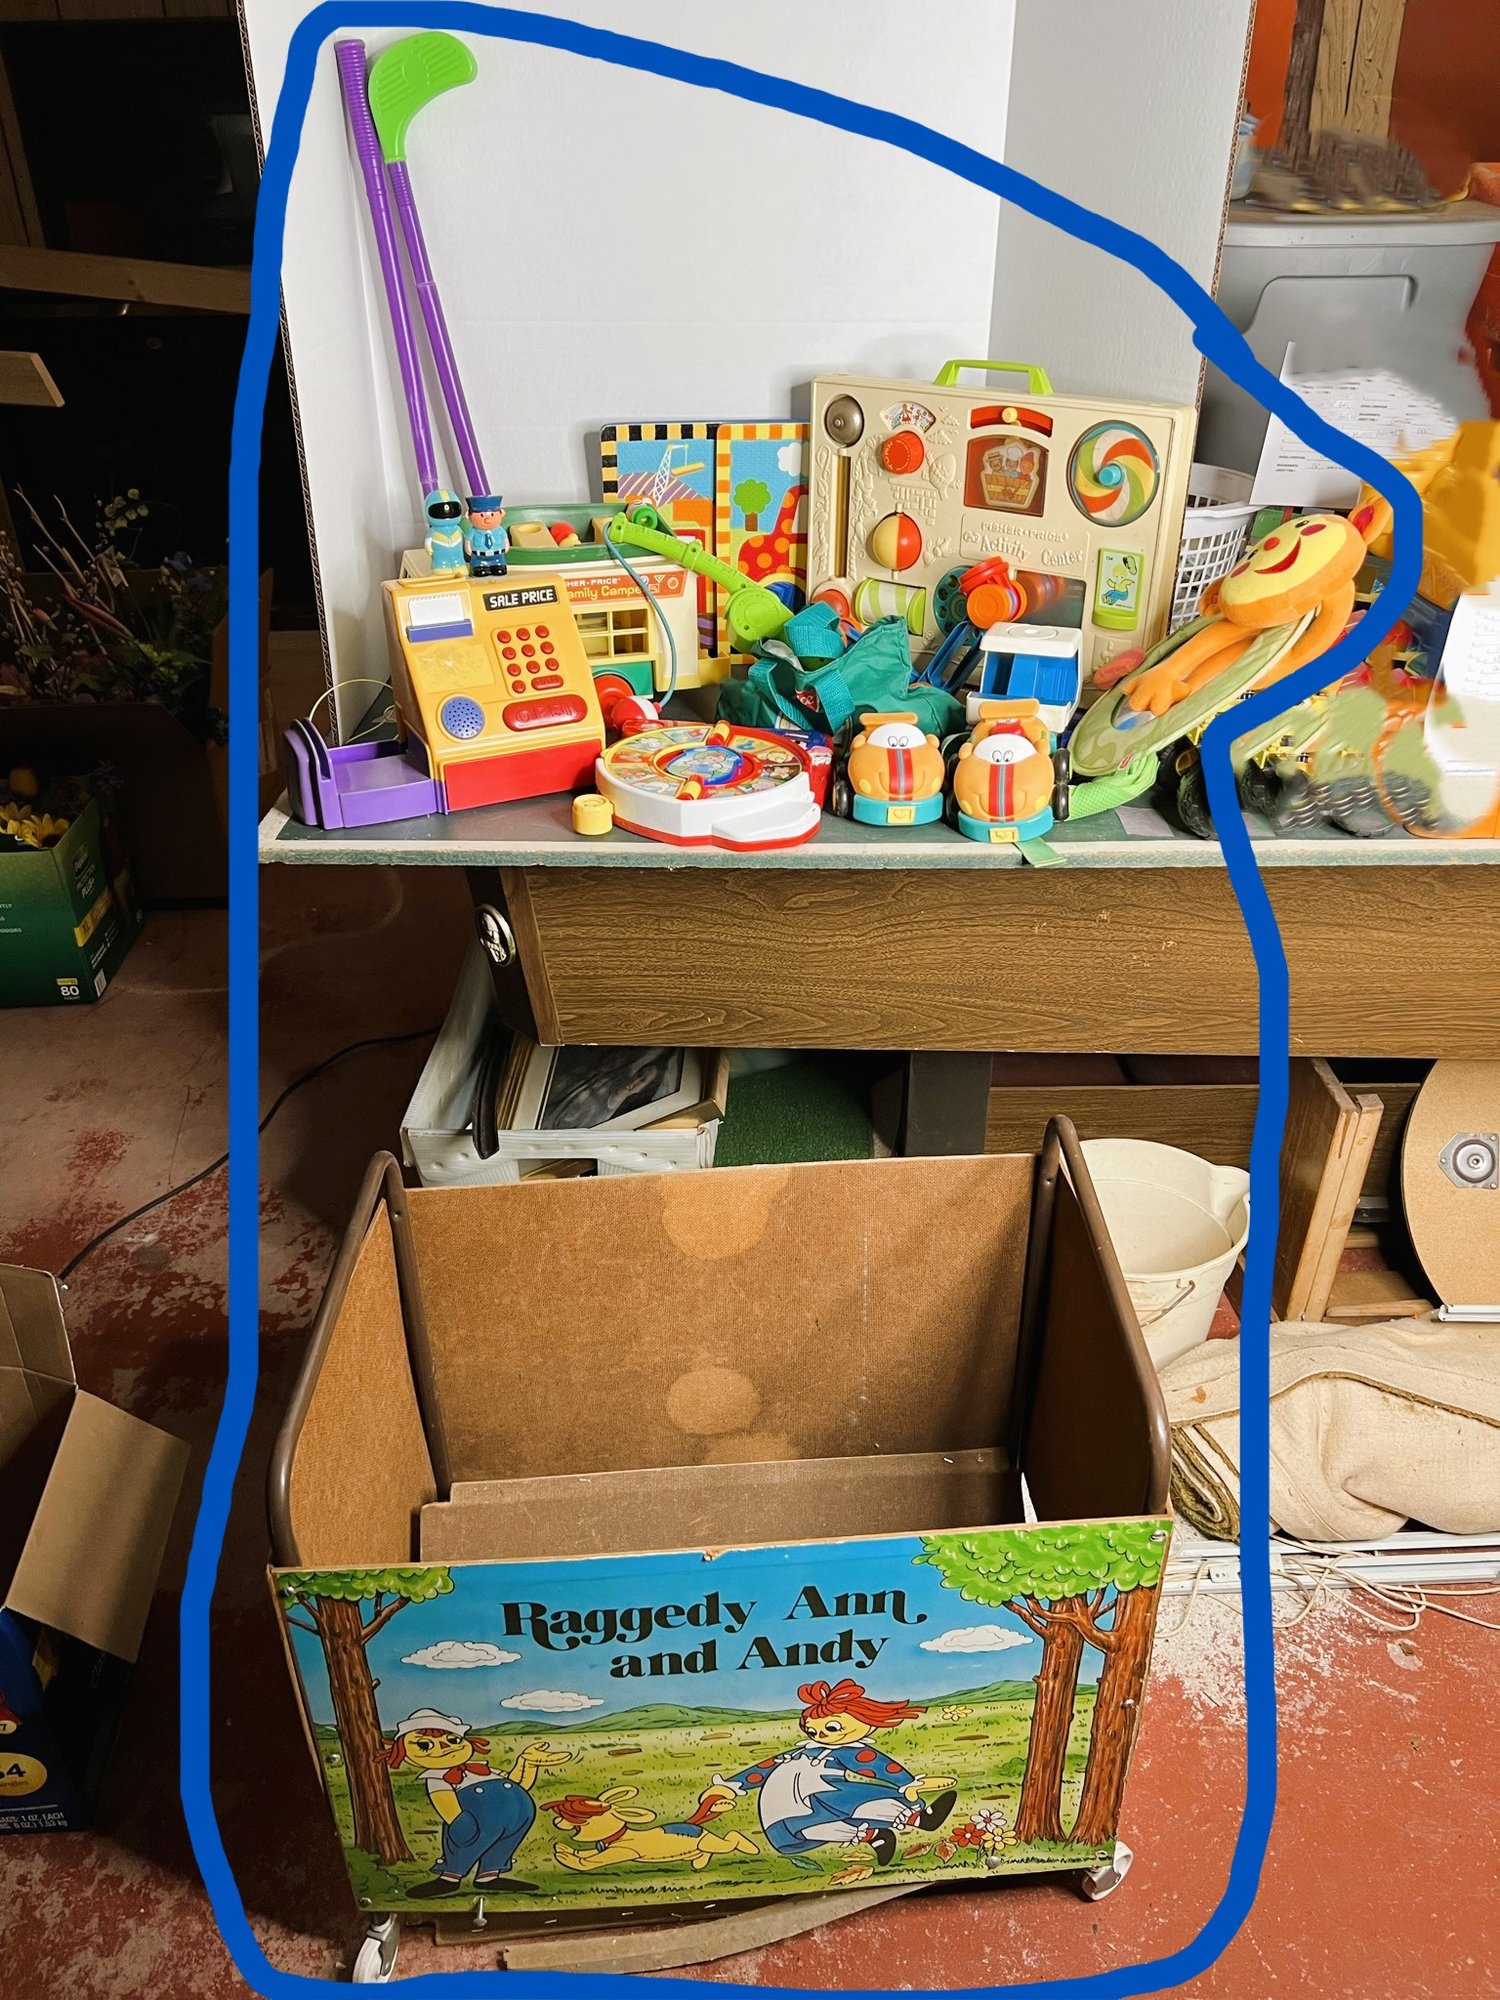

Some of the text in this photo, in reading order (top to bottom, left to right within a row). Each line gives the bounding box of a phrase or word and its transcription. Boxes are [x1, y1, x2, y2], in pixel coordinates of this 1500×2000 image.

[980, 534, 1083, 567] Activity Center
[489, 588, 554, 608] SALE PRICE
[567, 585, 642, 601] amily Campe
[515, 704, 576, 723] OPEN
[60, 985, 80, 996] 80
[501, 1584, 928, 1652] Raggedy Ann
[609, 1628, 890, 1678] and Andy
